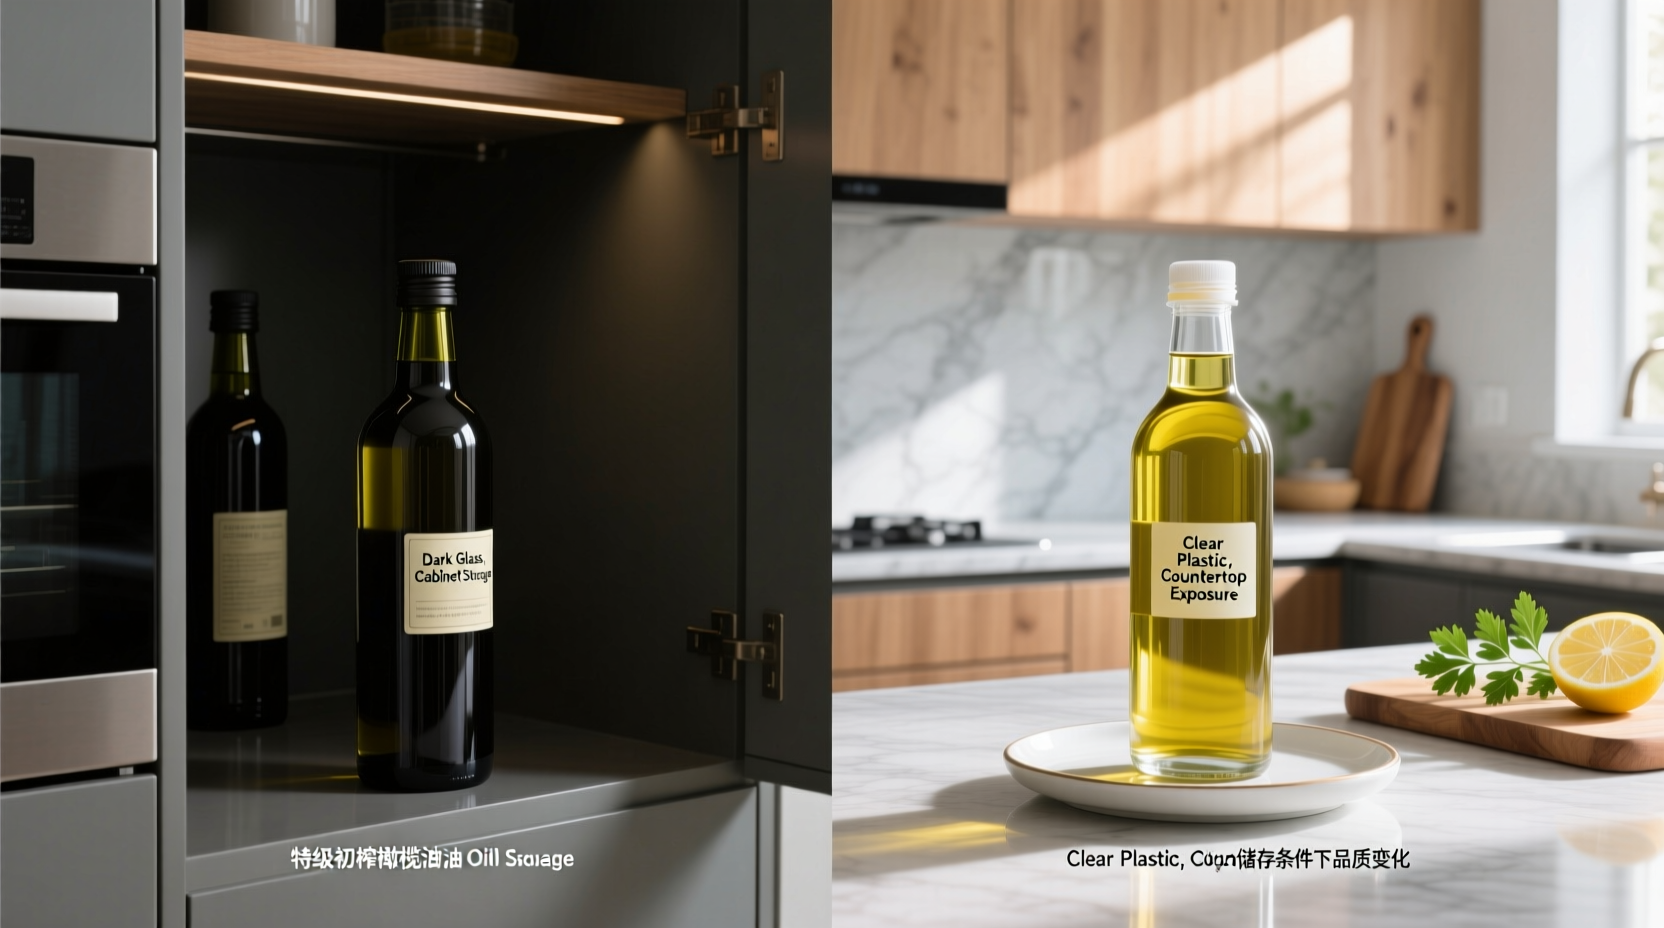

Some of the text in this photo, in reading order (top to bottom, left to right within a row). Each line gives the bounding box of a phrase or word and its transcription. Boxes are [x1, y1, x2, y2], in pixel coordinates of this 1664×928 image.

[1183, 535, 1224, 550] Clear
[422, 552, 453, 566] Dark
[1177, 552, 1233, 569] Plastic,
[414, 569, 461, 583] Cabinet
[1161, 568, 1247, 587] Countertop
[1170, 586, 1239, 604] Exposure
